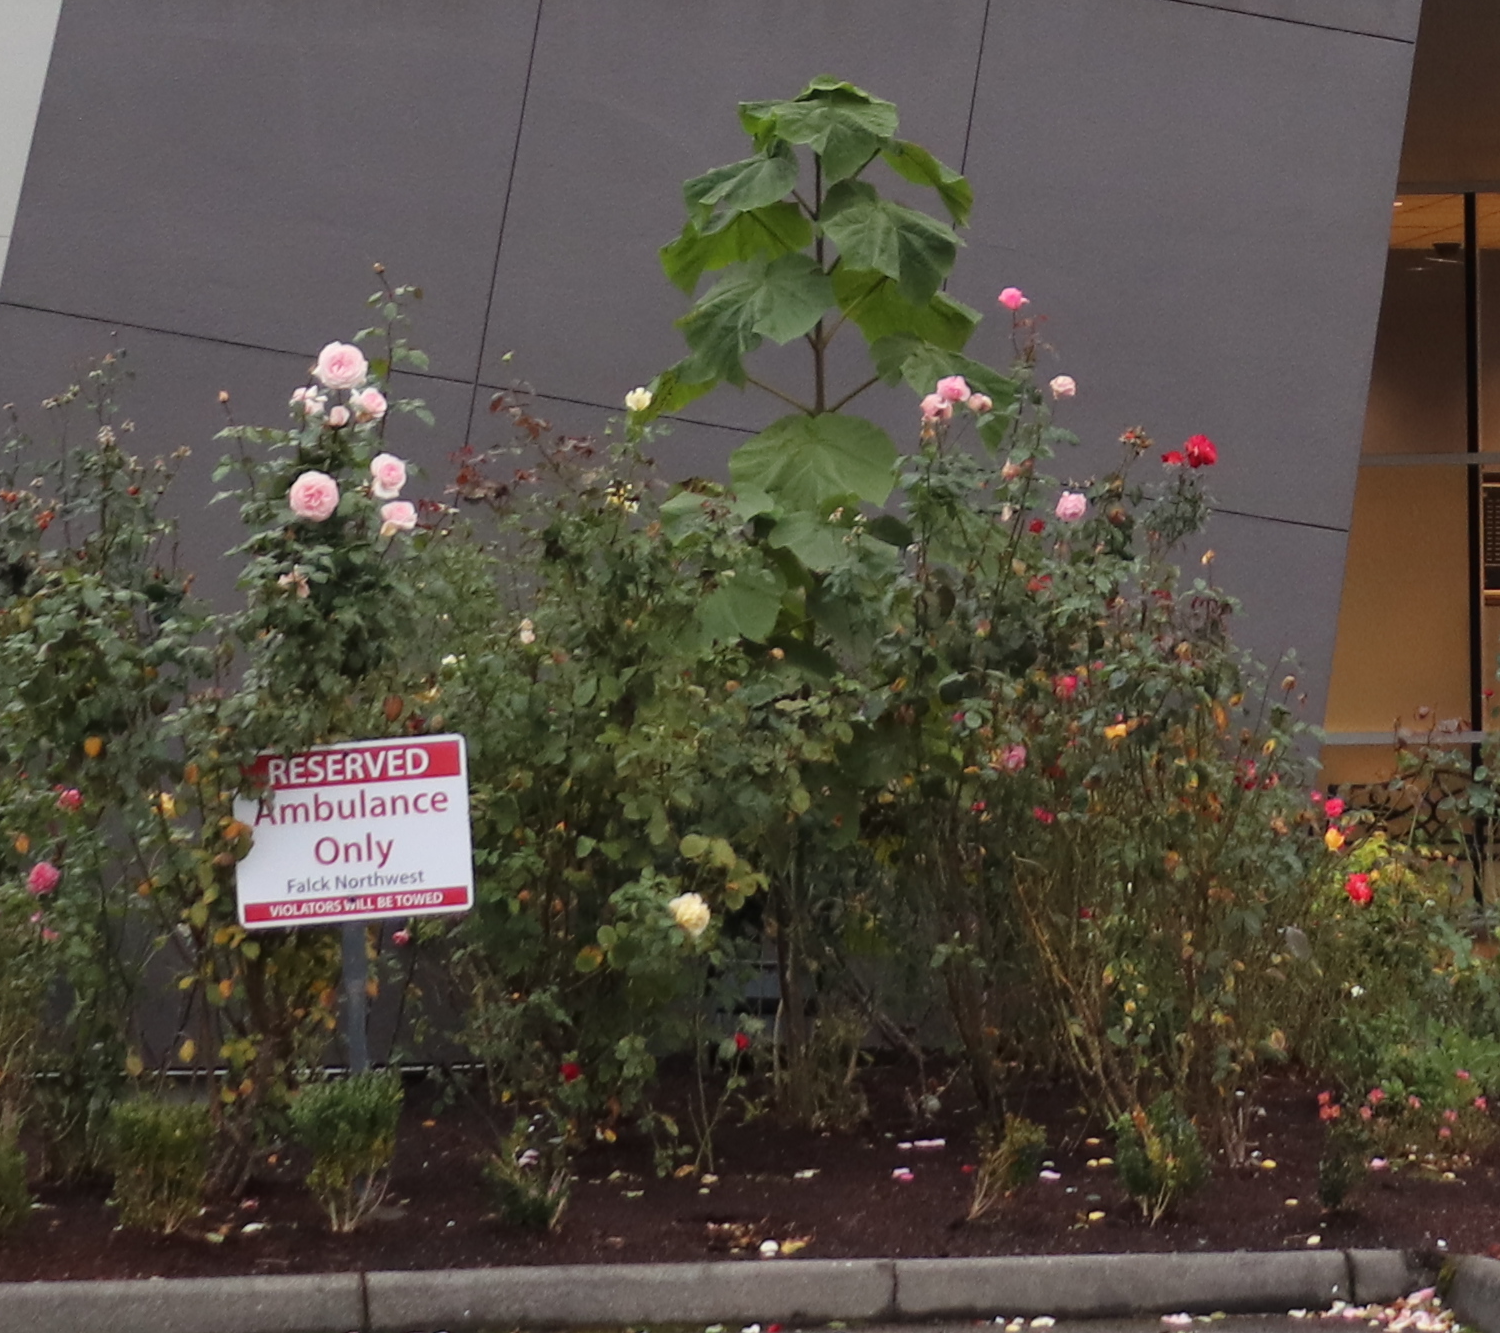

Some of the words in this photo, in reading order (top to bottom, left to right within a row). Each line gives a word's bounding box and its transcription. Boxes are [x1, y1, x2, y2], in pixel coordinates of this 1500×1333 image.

[268, 747, 430, 786] RESERVED
[253, 789, 449, 827] Ambulance
[314, 832, 394, 869] Only
[287, 873, 331, 894] Falck
[335, 869, 425, 891] Northwest
[269, 899, 342, 918] VIOLATORS
[344, 896, 375, 912] WILL
[377, 894, 395, 908] BE
[395, 891, 444, 907] TOWED
